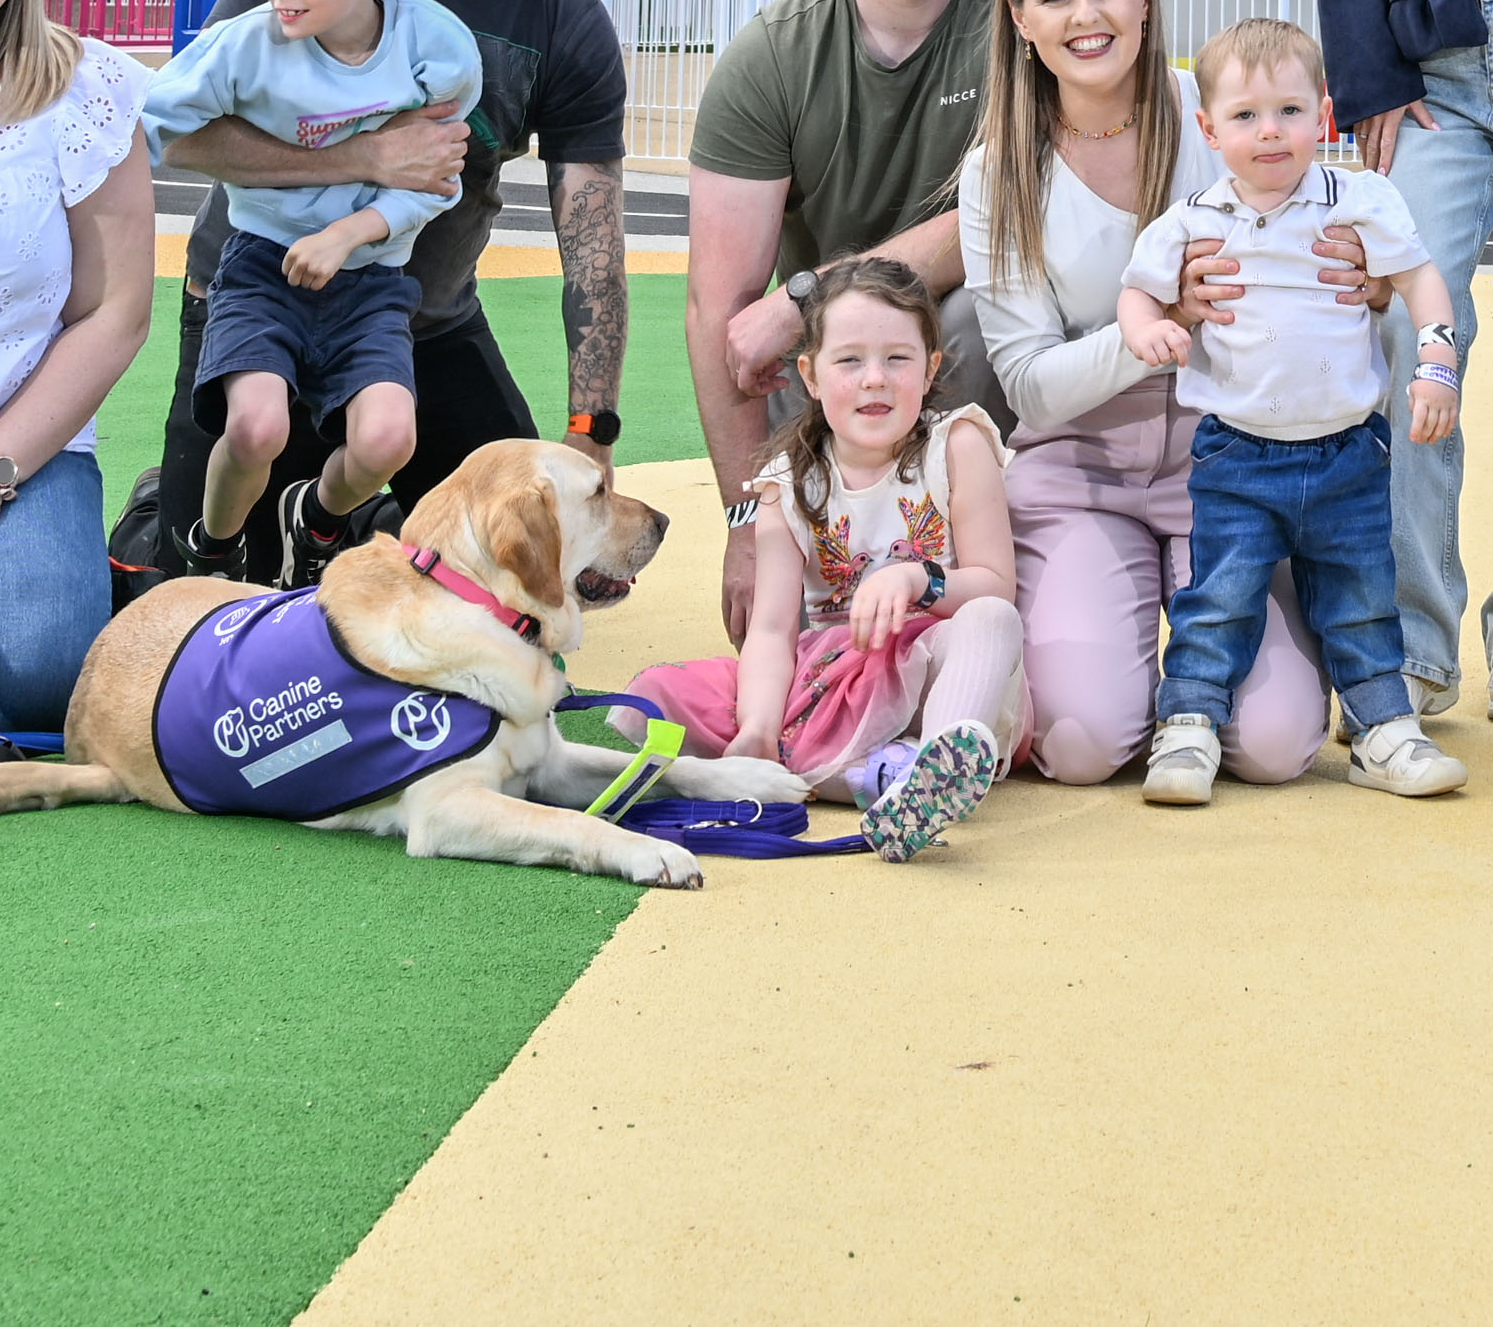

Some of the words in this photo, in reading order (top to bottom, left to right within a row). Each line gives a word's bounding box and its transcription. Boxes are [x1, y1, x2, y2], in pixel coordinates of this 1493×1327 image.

[940, 88, 977, 106] NICCE
[249, 676, 322, 722] Canine
[249, 691, 343, 747] Partners
